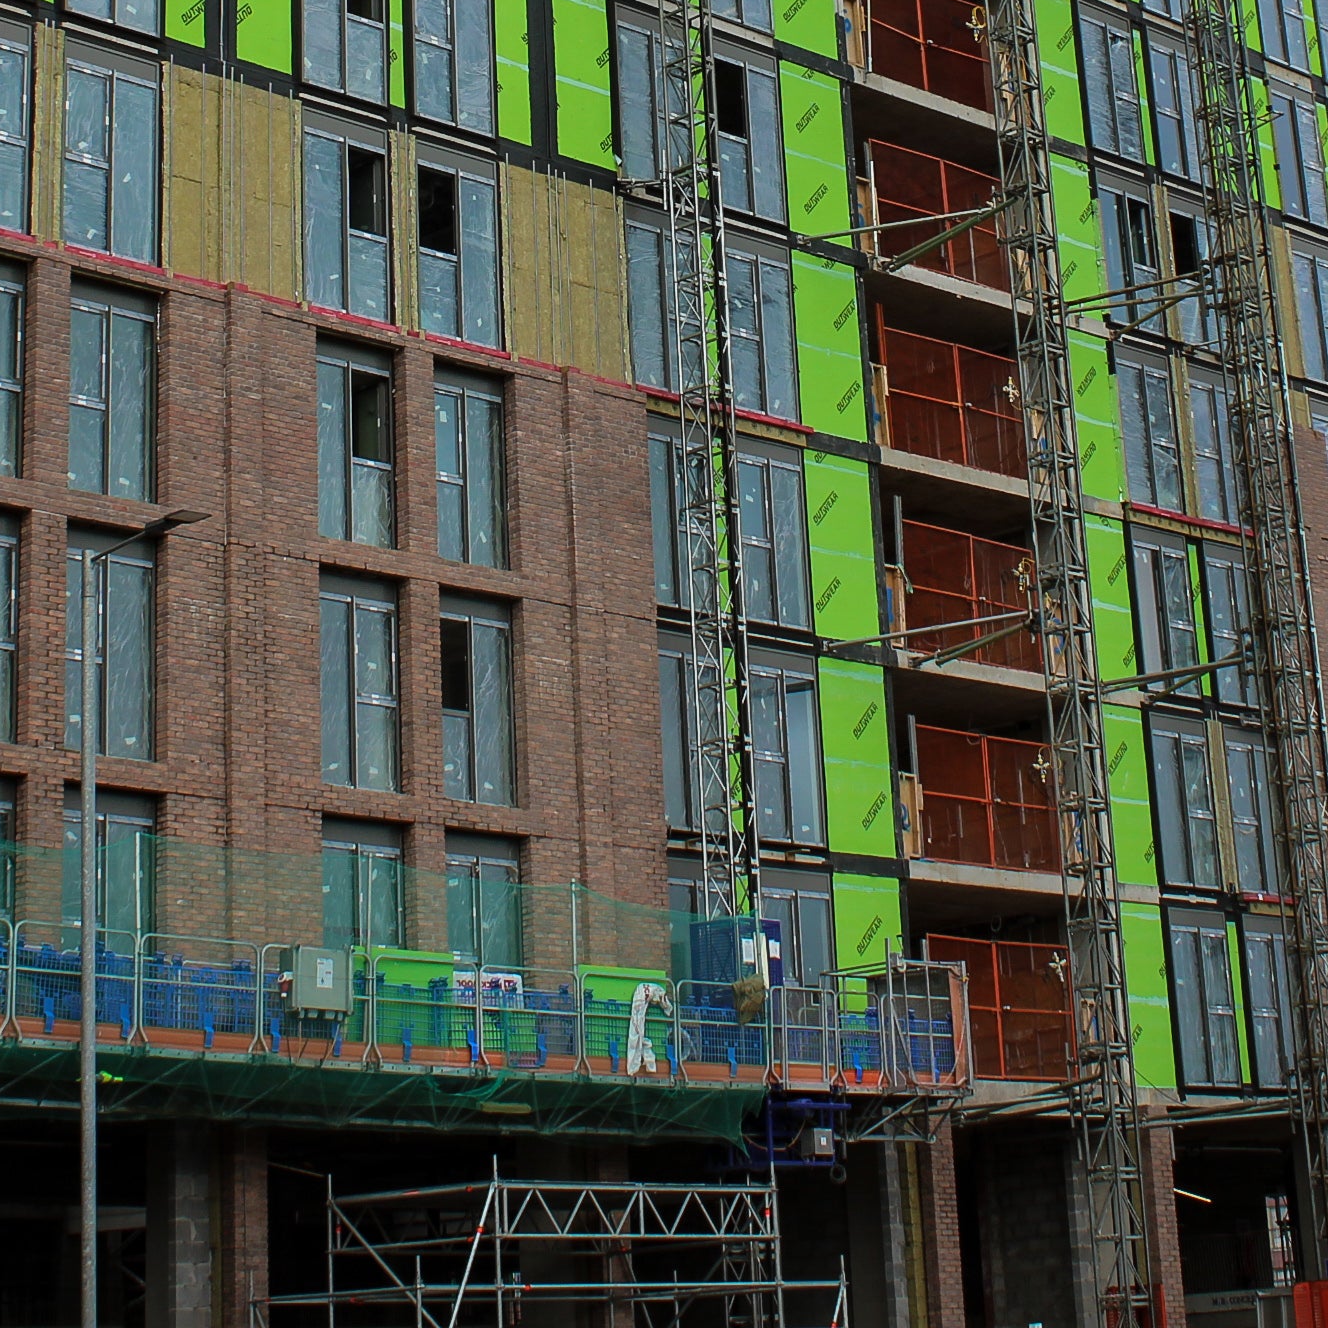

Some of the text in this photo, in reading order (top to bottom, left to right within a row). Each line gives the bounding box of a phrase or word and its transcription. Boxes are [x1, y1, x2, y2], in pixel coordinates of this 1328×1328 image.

[795, 105, 821, 132] OUTWEAR
[804, 184, 829, 213] OUTWEAR
[836, 383, 861, 413] OUTWEAR
[813, 491, 839, 525] OUTWEAR
[816, 578, 842, 612] OUTWEAR
[853, 703, 879, 738] OUTWEAR
[861, 793, 887, 829] OUTWEAR
[856, 917, 884, 955] OUTWEAR
